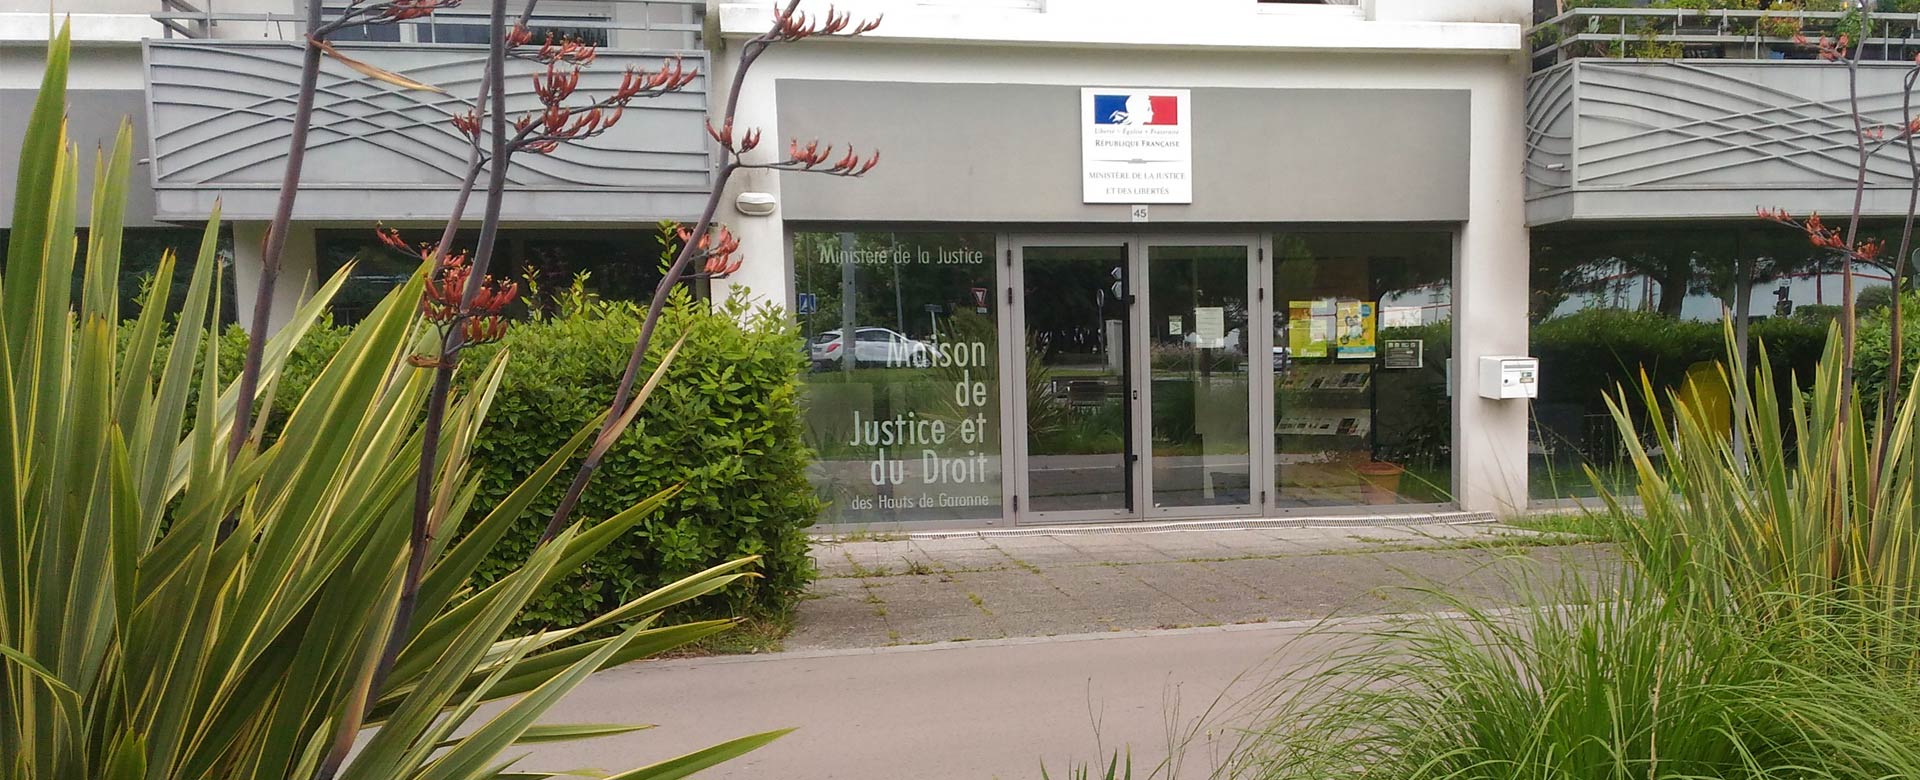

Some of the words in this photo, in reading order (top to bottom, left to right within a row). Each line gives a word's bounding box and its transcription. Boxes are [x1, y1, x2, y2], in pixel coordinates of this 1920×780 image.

[1132, 172, 1142, 180] DE
[1144, 172, 1154, 180] LA
[1156, 172, 1184, 180] JUSTICE
[1134, 186, 1169, 195] LIBERTÉS
[1133, 208, 1147, 218] 45
[819, 245, 887, 264] Ministère
[893, 245, 911, 264] de
[917, 245, 930, 264] la
[937, 246, 983, 264] Justice
[886, 333, 986, 368] Maison
[955, 370, 987, 407] de
[850, 411, 945, 447] Justice
[960, 412, 987, 443] et
[871, 448, 904, 486] du
[923, 450, 988, 484] Droit
[852, 495, 873, 511] des
[878, 494, 914, 510] Hauts
[919, 493, 934, 508] de
[938, 492, 989, 508] Garonne
